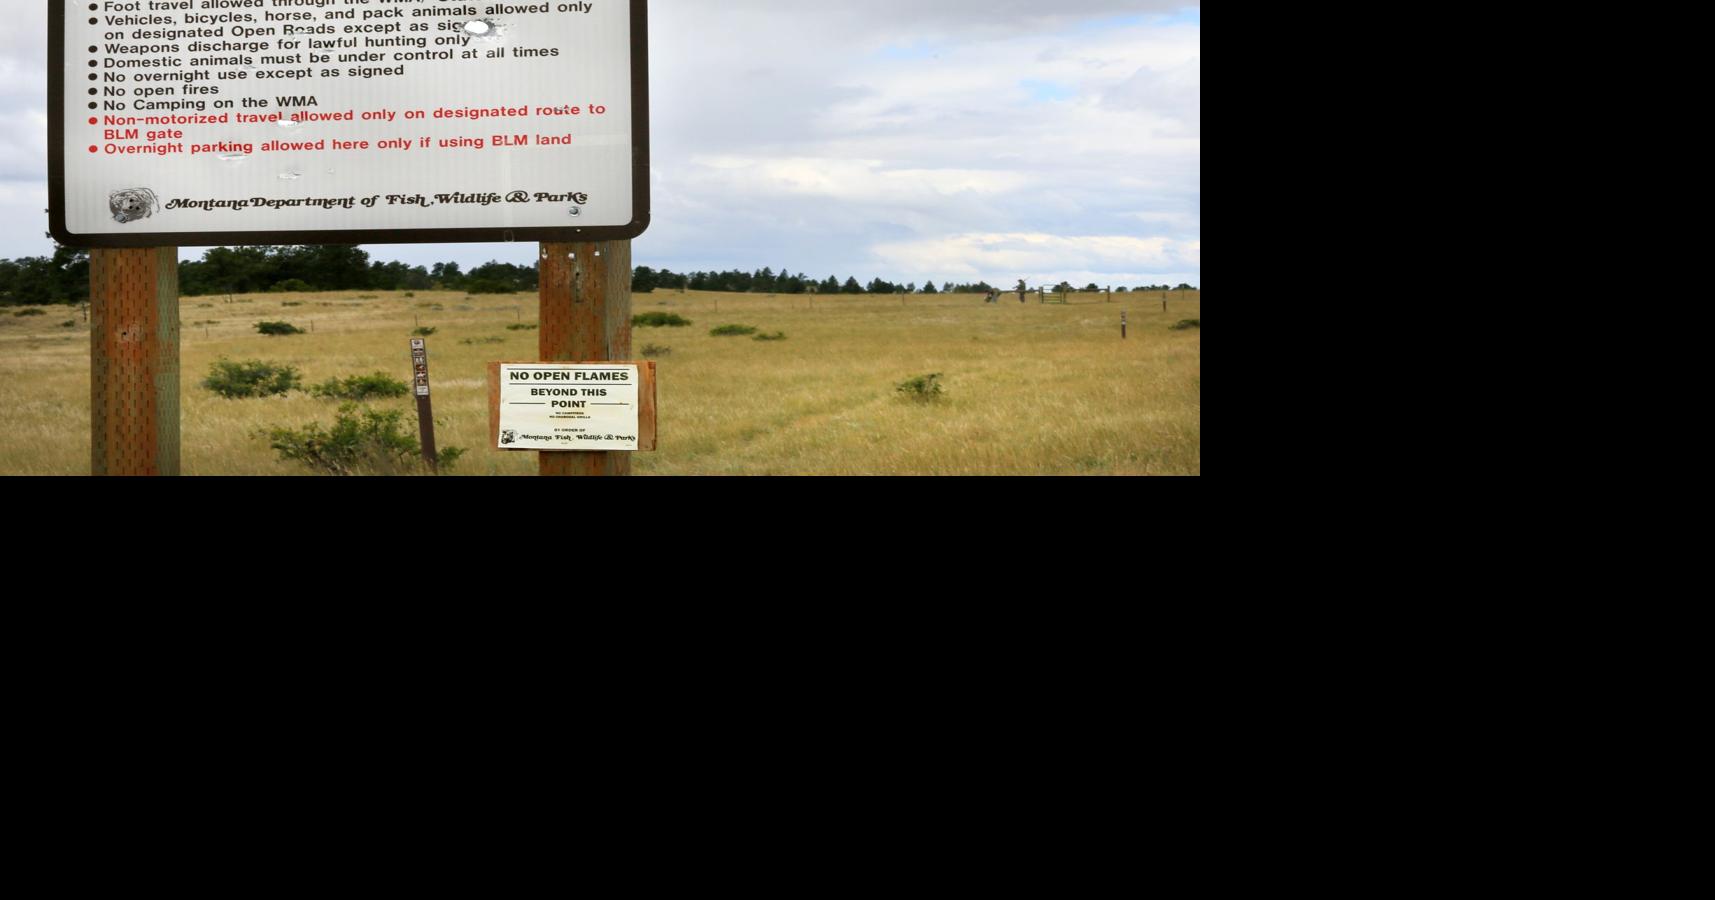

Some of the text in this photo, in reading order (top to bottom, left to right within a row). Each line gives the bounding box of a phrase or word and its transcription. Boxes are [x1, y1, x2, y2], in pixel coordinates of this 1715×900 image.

[104, 1, 141, 12] Foot
[149, 0, 193, 10] travel
[200, 0, 264, 9] allowed
[104, 2, 592, 26] Vehicles, bicycles, horse, and pack animals allowed only
[104, 30, 124, 40] on
[132, 27, 224, 40] designated
[232, 26, 275, 38] Open
[344, 22, 401, 34] except
[410, 22, 428, 32] as
[105, 34, 470, 54] Weapons discharge for lawful hunting only
[104, 46, 560, 68] Domestic animals must be under control at all times
[104, 65, 404, 82] No overnight use except as signed
[104, 84, 220, 98] No open fires
[104, 96, 318, 112] No Camping on the WMA
[104, 104, 606, 126] Non-motorized travel allowed only on designated route to
[104, 129, 182, 142] BLM gate
[104, 134, 572, 156] Overnight parking allowed here only if using BLM land
[165, 197, 249, 211] Montana
[250, 196, 355, 209] Department
[361, 195, 379, 208] of
[505, 190, 530, 203] &
[534, 191, 588, 203] Parks
[510, 372, 629, 380] NO OPEN FLAMES
[531, 388, 607, 396] BEYOND THIS
